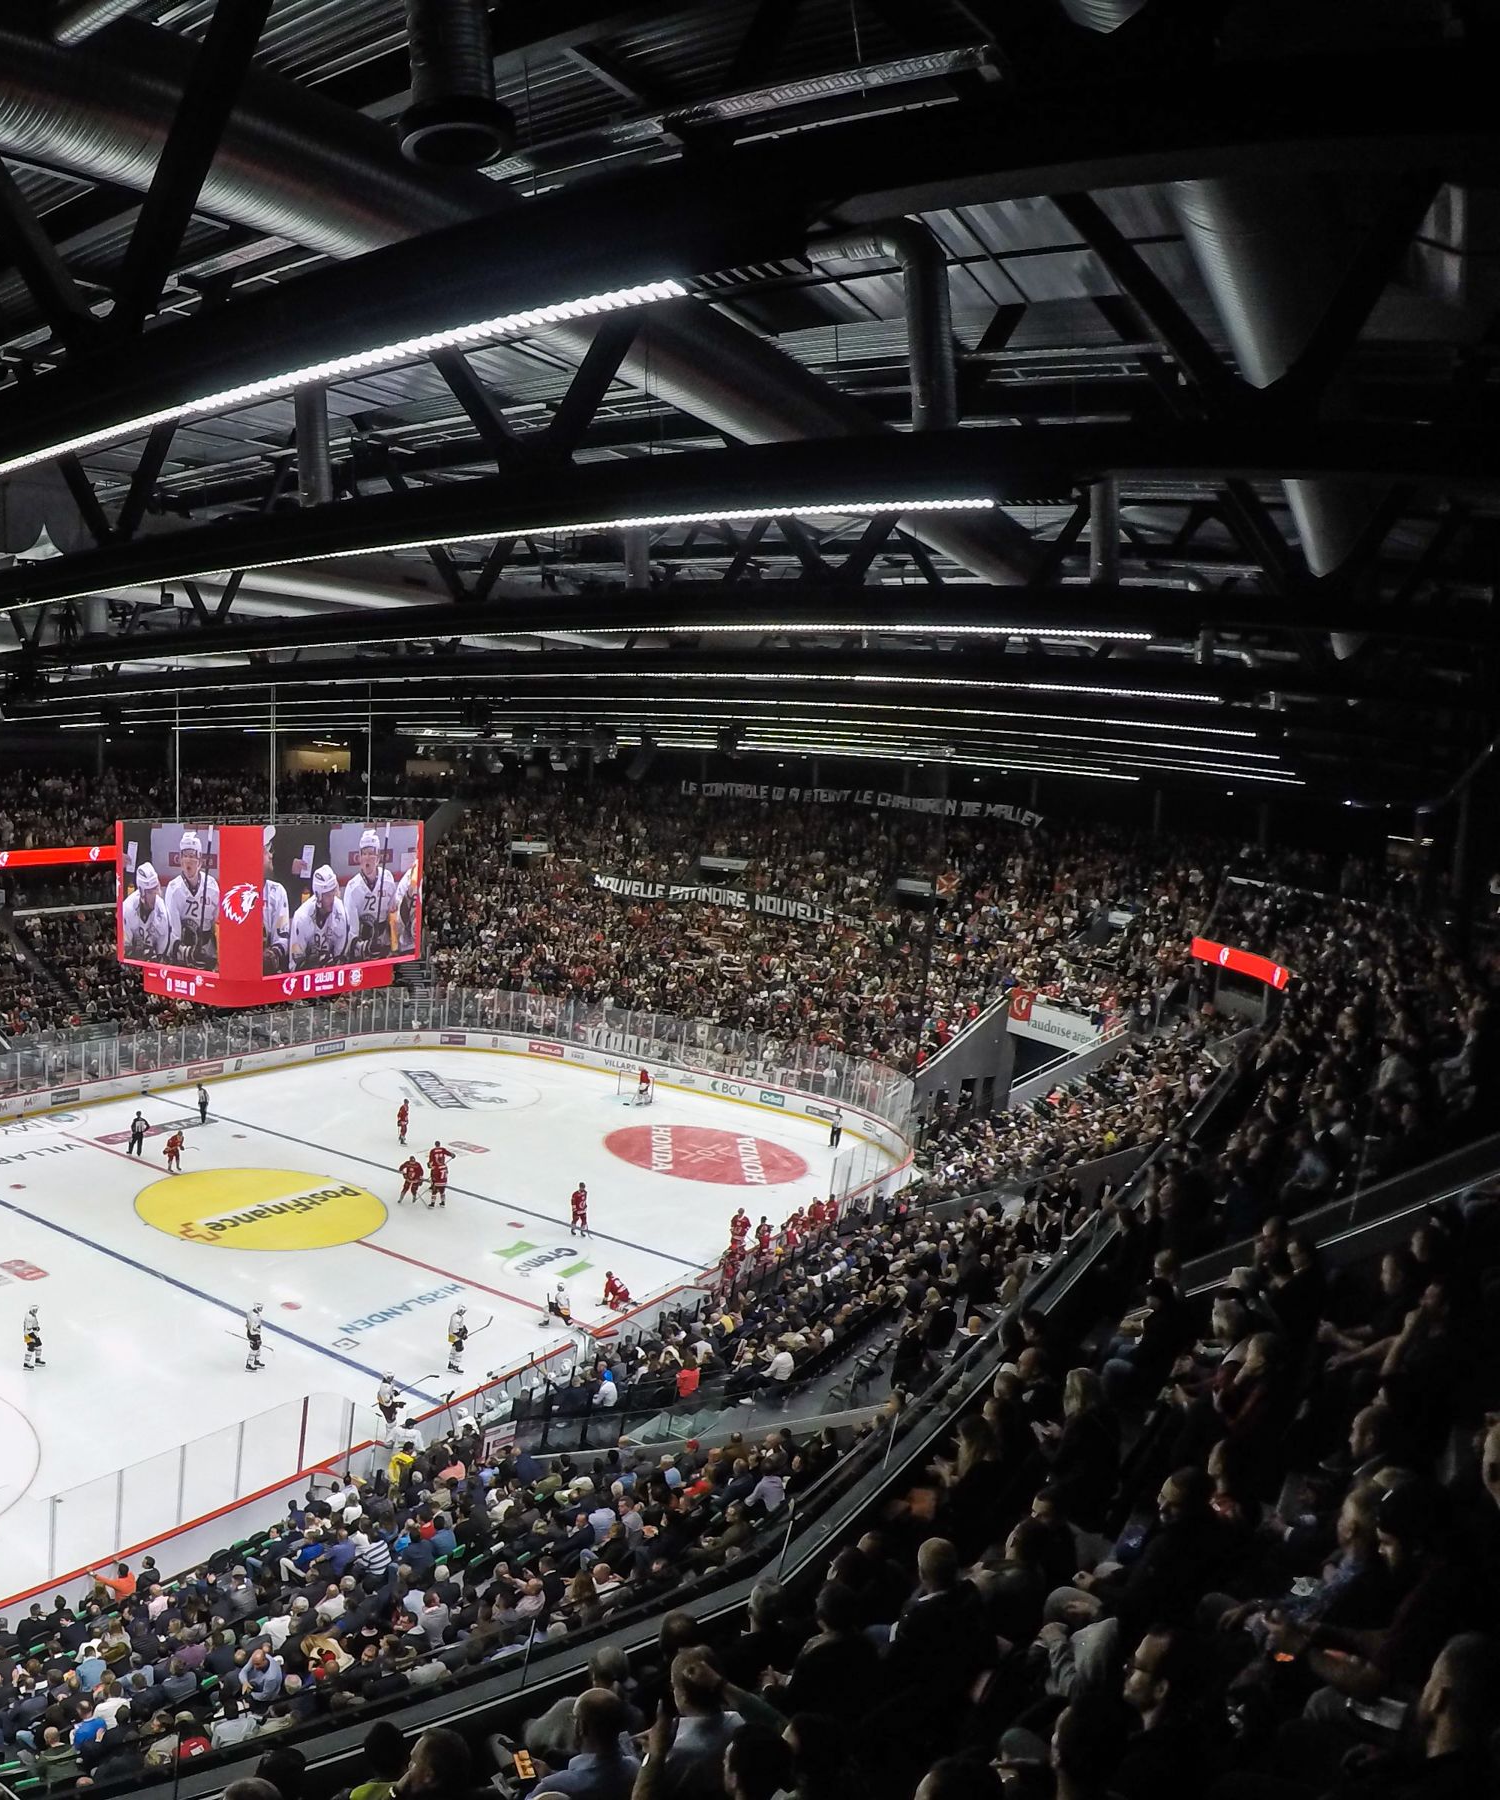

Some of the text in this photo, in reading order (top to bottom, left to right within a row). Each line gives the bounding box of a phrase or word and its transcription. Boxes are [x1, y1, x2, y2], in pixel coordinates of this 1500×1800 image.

[681, 780, 697, 796] LE
[185, 899, 199, 918] 72
[364, 895, 376, 911] 72
[593, 874, 666, 898] NOUVELLE
[754, 894, 834, 925] NOUVELLE
[314, 933, 327, 950] 92
[303, 974, 311, 992] 0
[337, 970, 344, 987] 0
[721, 1082, 746, 1097] BCV
[651, 1126, 673, 1171] HONDA
[736, 1136, 768, 1184] HONDA
[205, 1185, 362, 1232] PostFinance
[514, 1246, 578, 1272] Cremo
[338, 1282, 466, 1334] HIRSLANDEN
